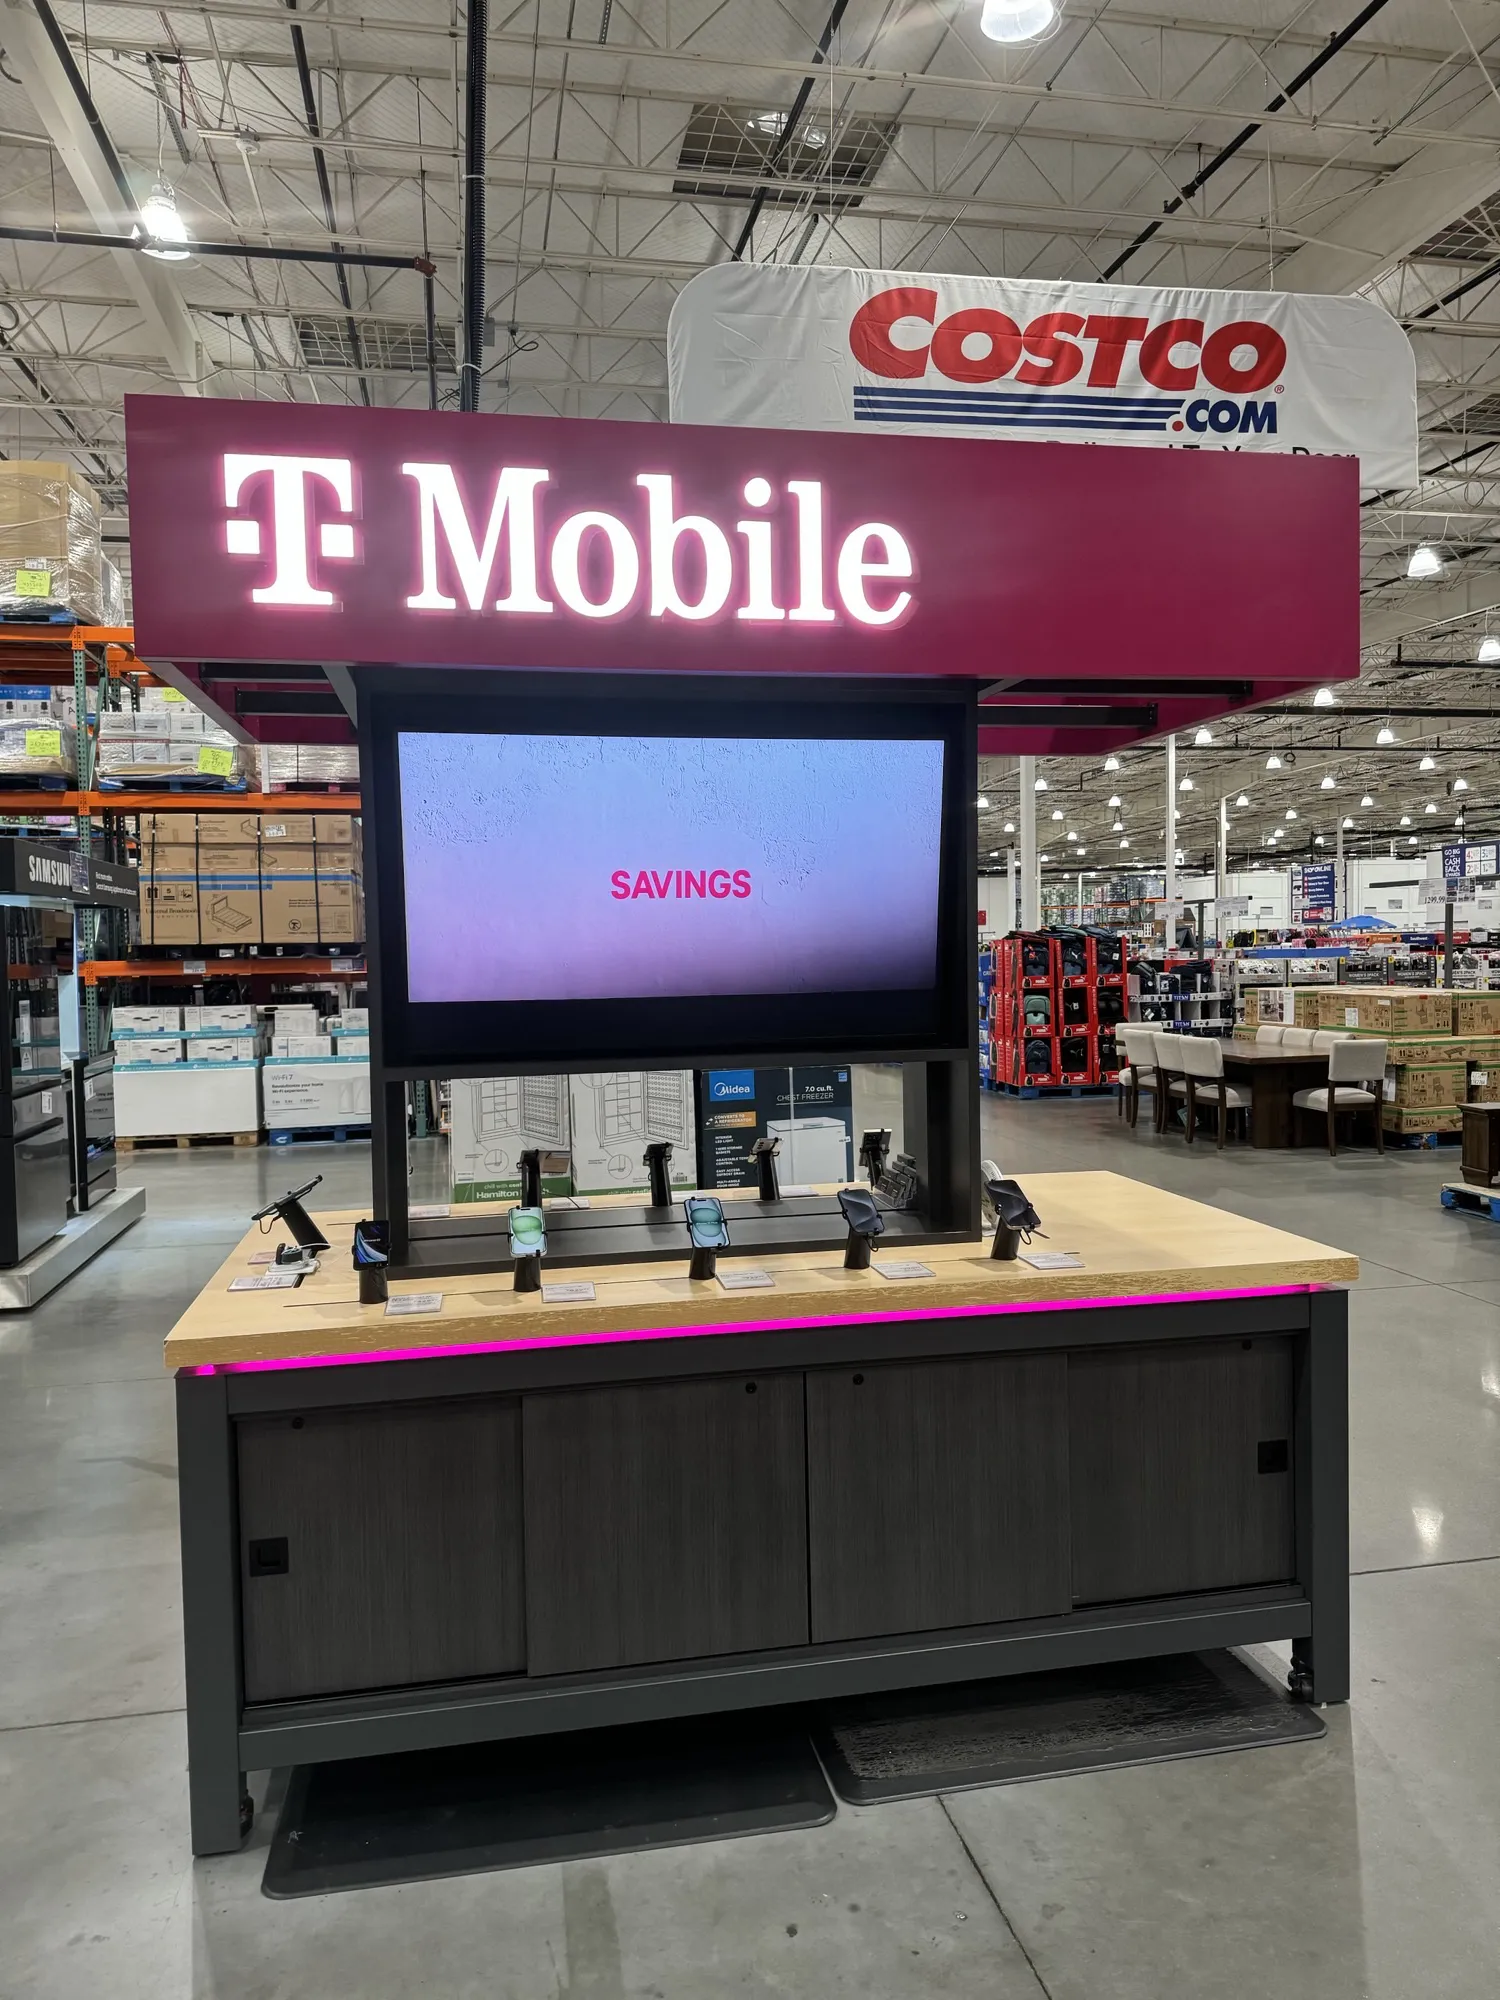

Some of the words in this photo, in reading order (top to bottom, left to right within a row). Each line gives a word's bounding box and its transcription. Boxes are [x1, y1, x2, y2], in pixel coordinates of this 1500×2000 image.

[849, 287, 1287, 394] COSTCO
[1171, 399, 1278, 435] .COM
[223, 453, 355, 606] T
[402, 462, 913, 626] Mobile
[28, 855, 72, 887] SAMSUN
[1444, 857, 1461, 866] CASH
[610, 869, 752, 900] SAVINGS
[1424, 895, 1446, 904] 1299.99
[714, 1082, 750, 1096] Midea
[776, 1093, 801, 1101] CHEST
[802, 1092, 834, 1101] FREEZER
[476, 1190, 519, 1199] Hamilton
